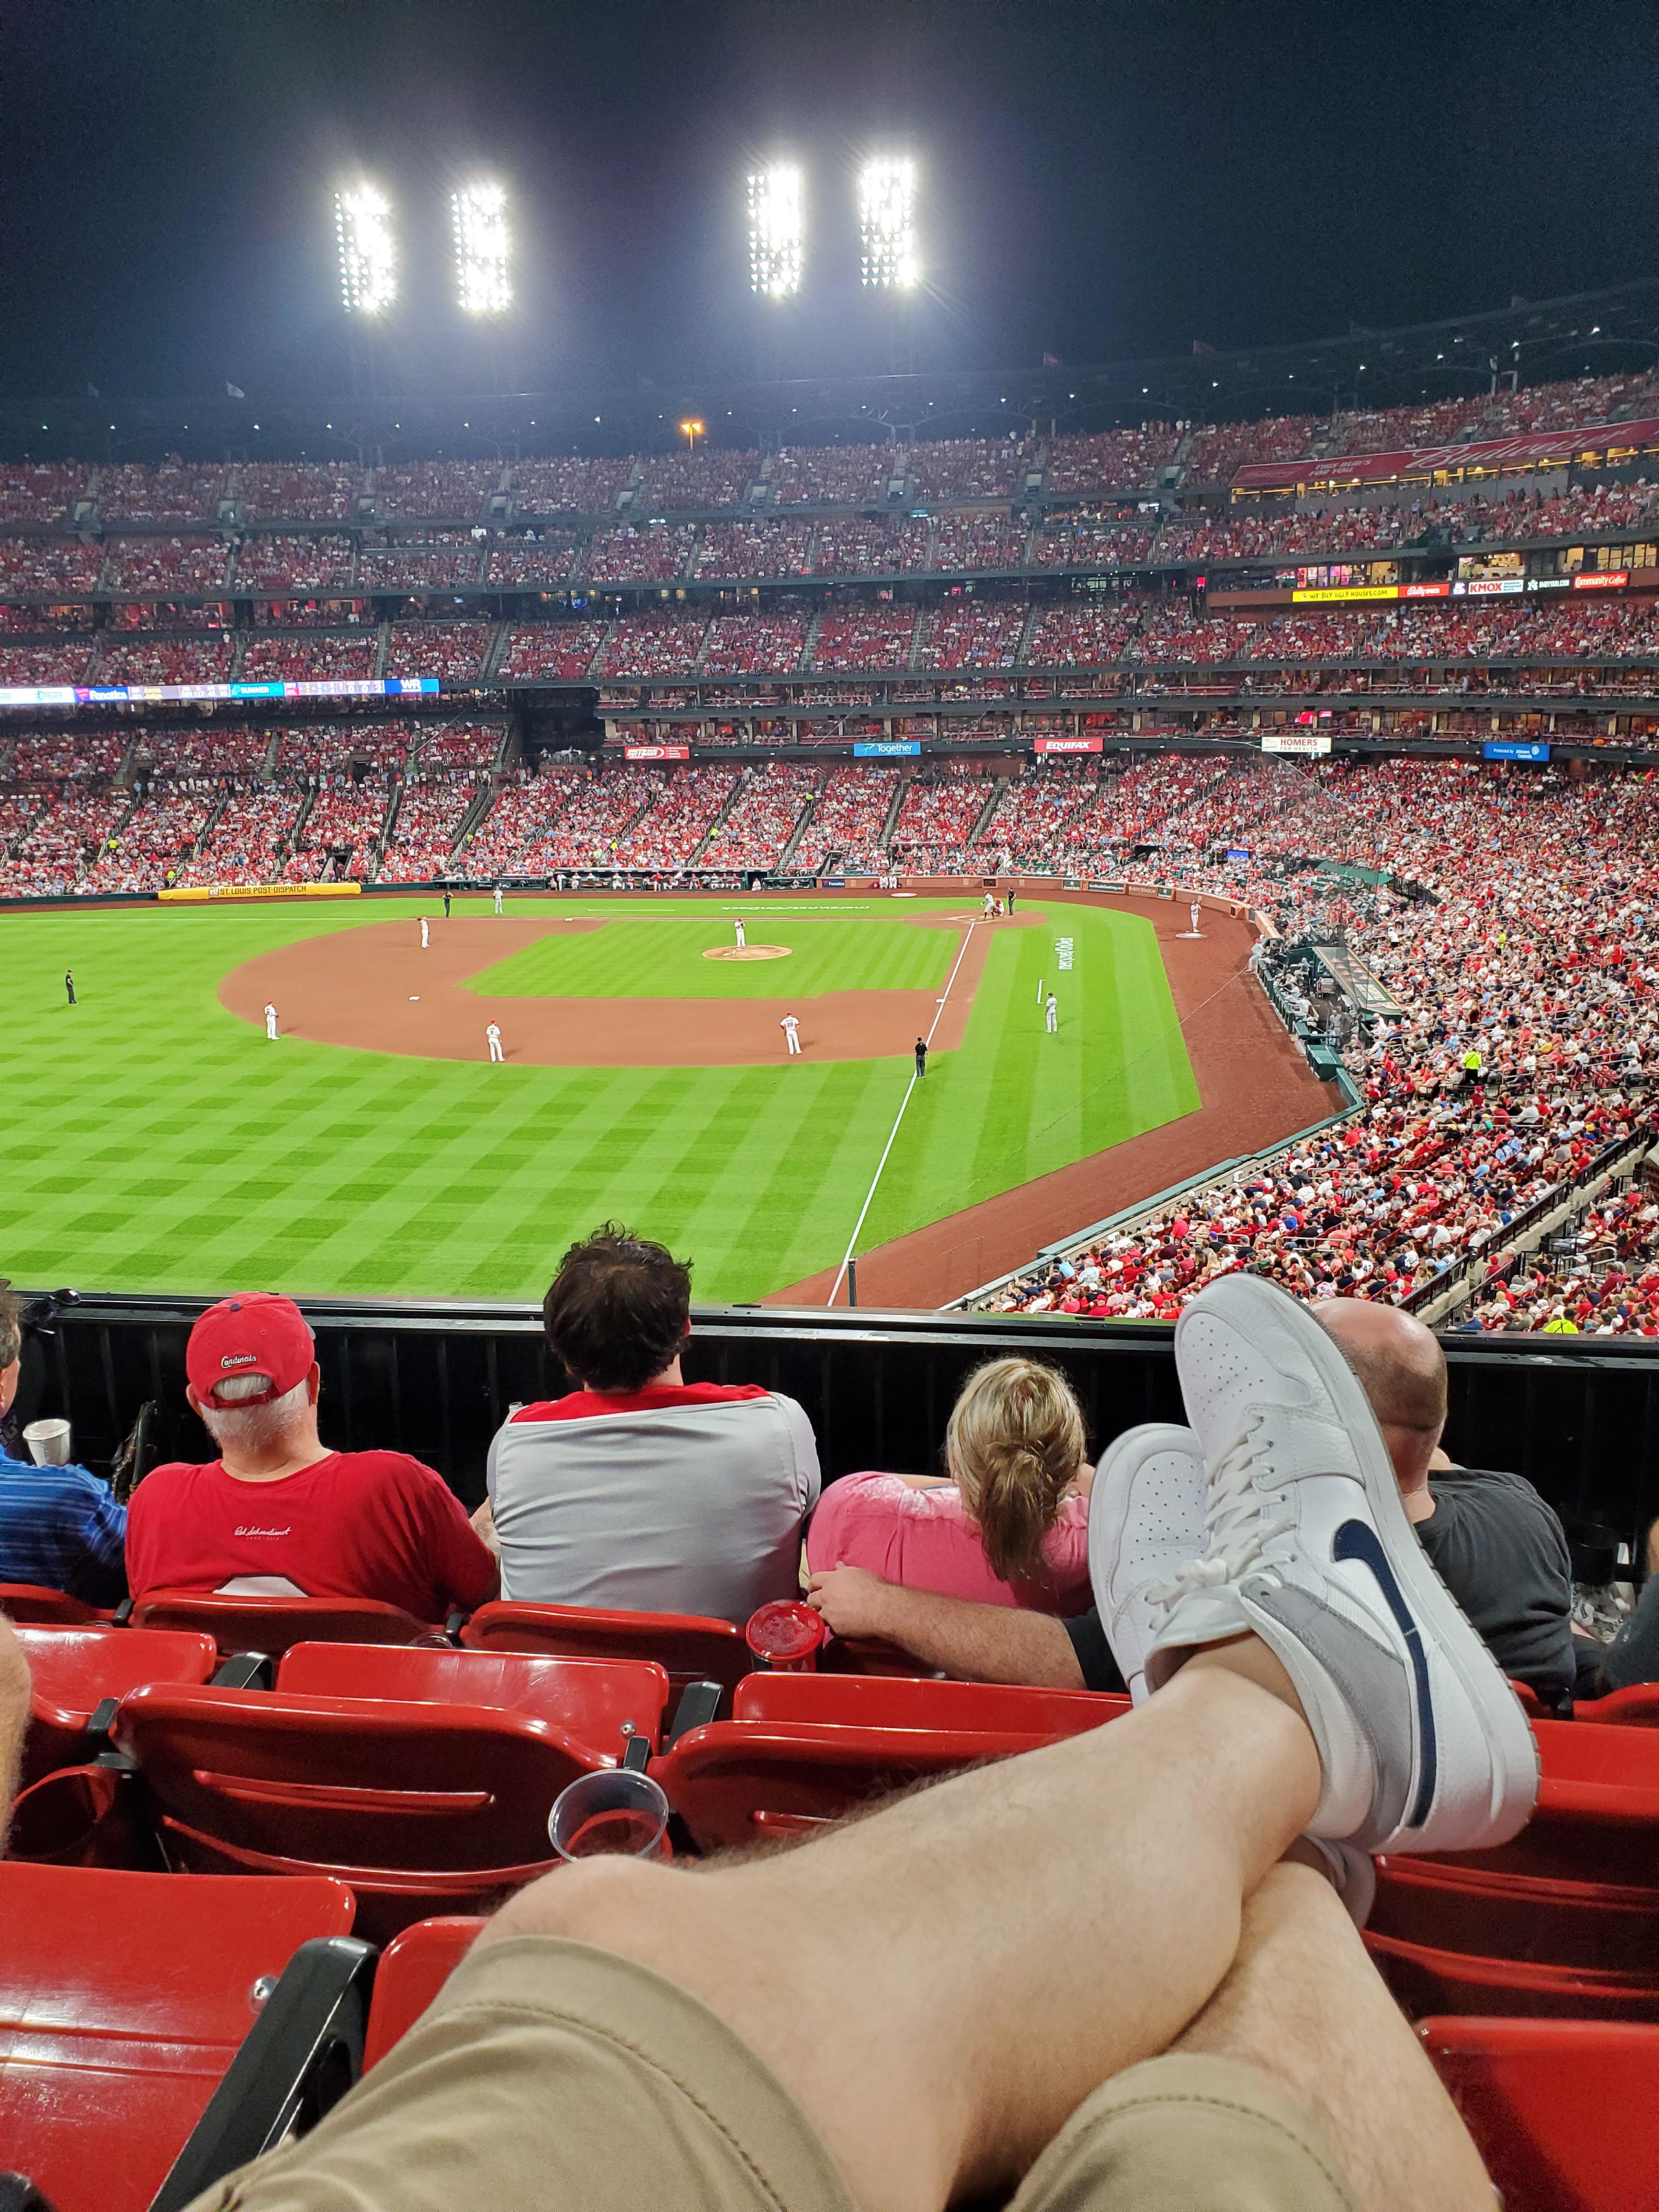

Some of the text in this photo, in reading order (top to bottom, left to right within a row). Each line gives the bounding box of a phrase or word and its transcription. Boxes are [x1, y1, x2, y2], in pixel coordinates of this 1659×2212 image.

[1405, 428, 1630, 469] Budweiser
[1575, 575, 1627, 588] Community Coffee
[1407, 585, 1426, 596] Bally
[1470, 582, 1503, 593] KMOX
[400, 679, 421, 689] WR
[89, 690, 128, 700] Fanatics
[877, 743, 913, 754] Together
[1046, 741, 1091, 752] EQUIFAX
[253, 885, 306, 894] POST-DISPATCH
[1363, 1264, 1372, 1273] 42
[221, 1354, 257, 1369] Cardinals
